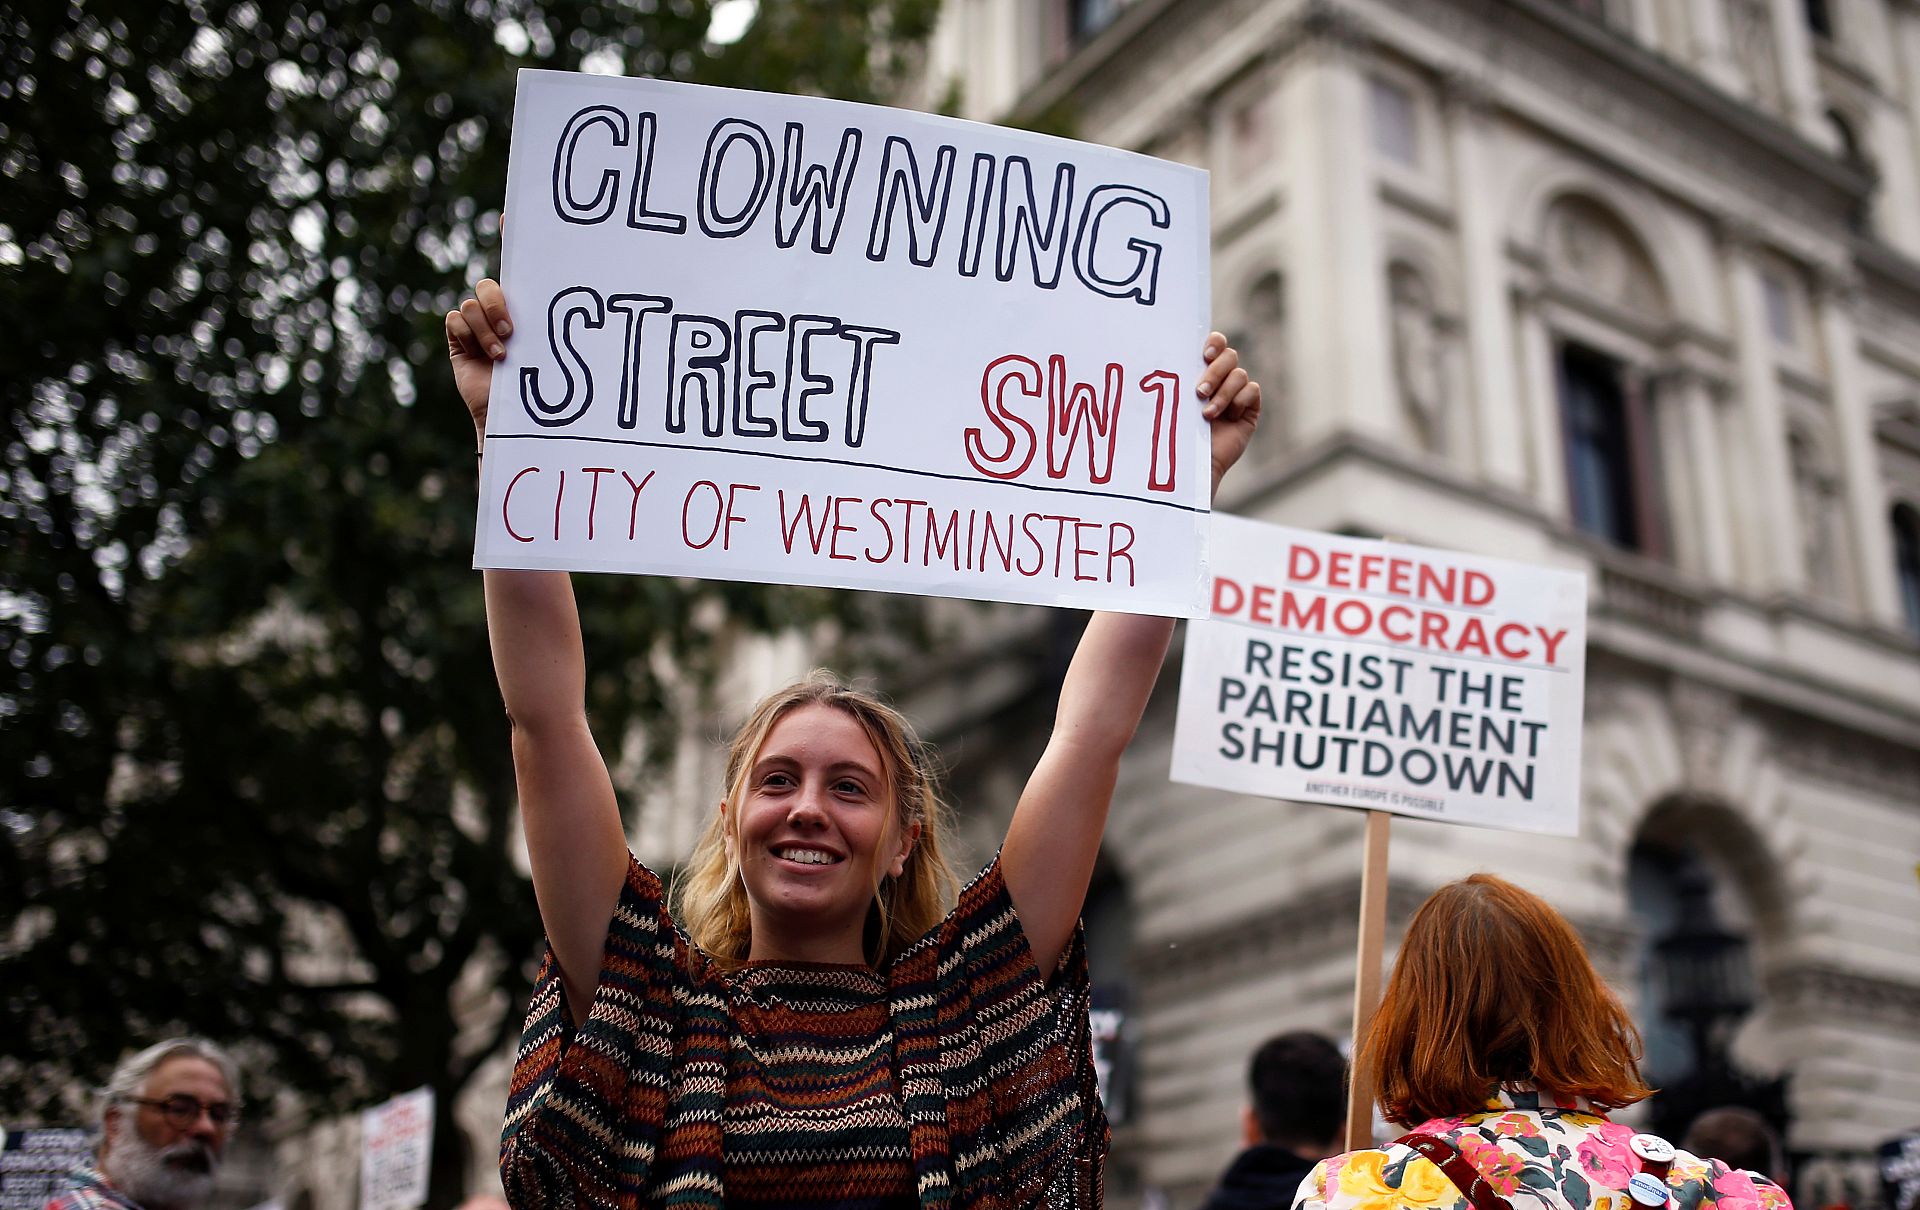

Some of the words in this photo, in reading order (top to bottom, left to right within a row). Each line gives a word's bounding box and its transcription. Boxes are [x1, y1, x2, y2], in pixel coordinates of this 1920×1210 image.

[553, 105, 1170, 305] CLOWNING
[519, 286, 900, 448] STREET
[965, 354, 1180, 492] SW1
[504, 468, 655, 542] CITY
[683, 481, 760, 549] OF
[778, 490, 1135, 586] WESTMINSTER
[1288, 544, 1496, 607] DEFEND
[1211, 577, 1568, 665] DEMOCRACY
[1246, 640, 1413, 694] RESIST
[1431, 667, 1523, 712] THE
[1219, 678, 1547, 757] PARLIAMENT
[1219, 723, 1534, 800] SHUTDOWN
[1305, 783, 1349, 798] ANOTHER
[1353, 788, 1386, 803] EUROPE
[1389, 793, 1399, 804] IS
